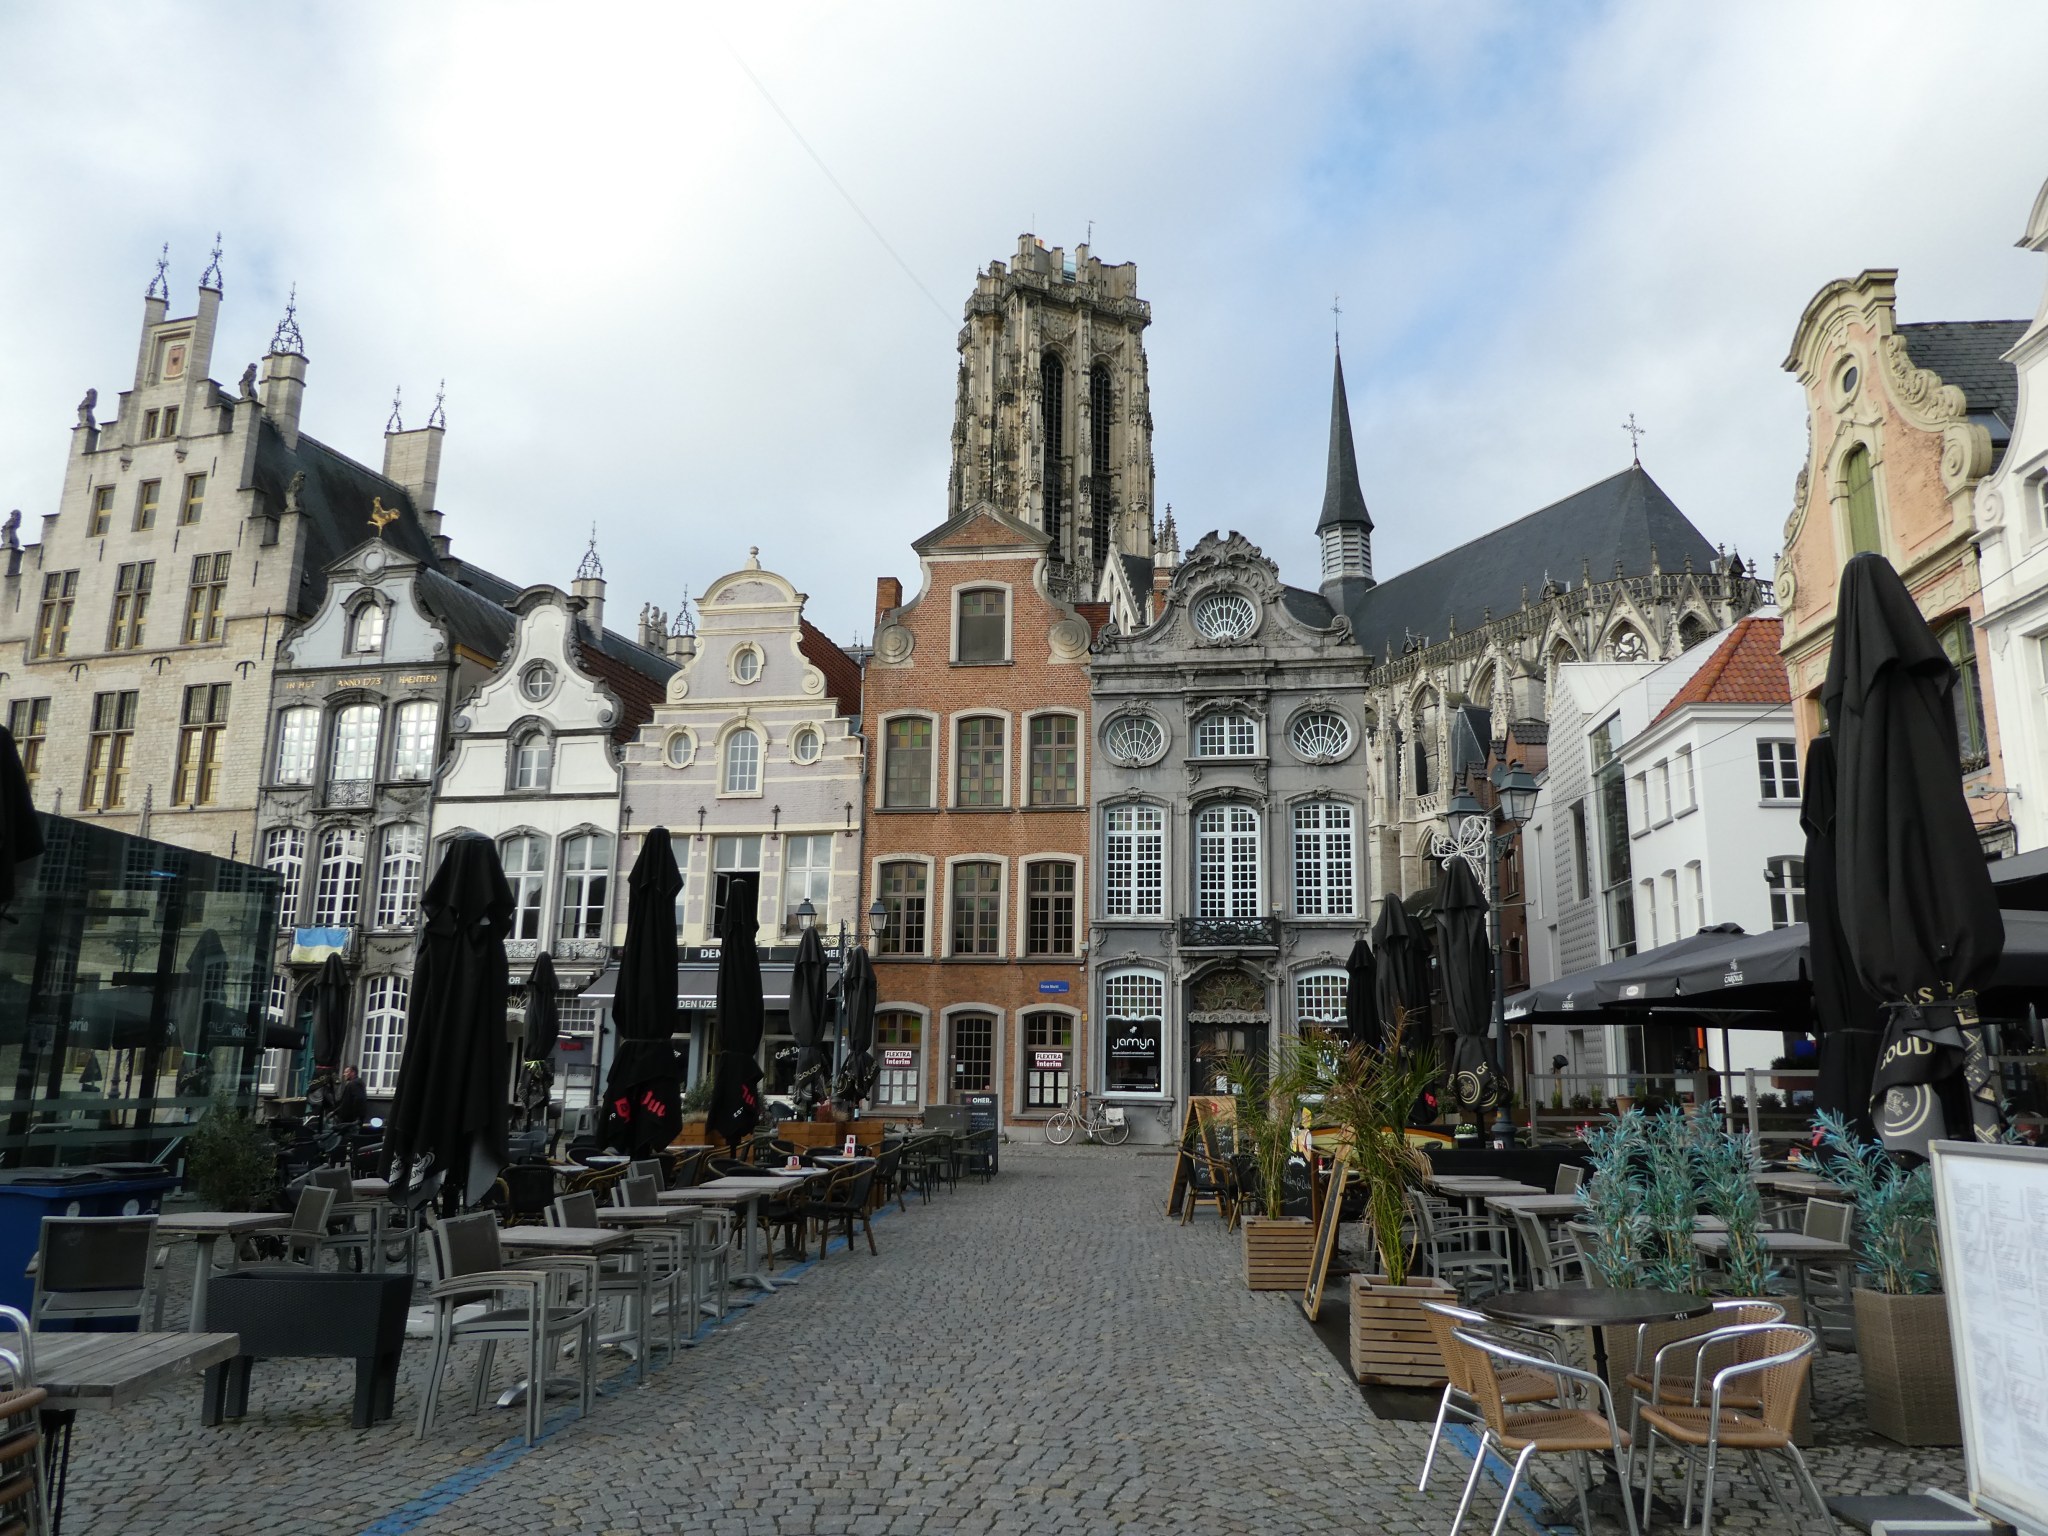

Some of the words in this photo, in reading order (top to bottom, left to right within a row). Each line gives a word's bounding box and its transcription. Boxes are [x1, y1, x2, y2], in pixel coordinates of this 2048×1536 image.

[286, 681, 296, 689] IN
[363, 677, 381, 686] 1773
[678, 1000, 697, 1008] DEN
[698, 1000, 717, 1008] IJZE
[1112, 1038, 1155, 1050] jamyn
